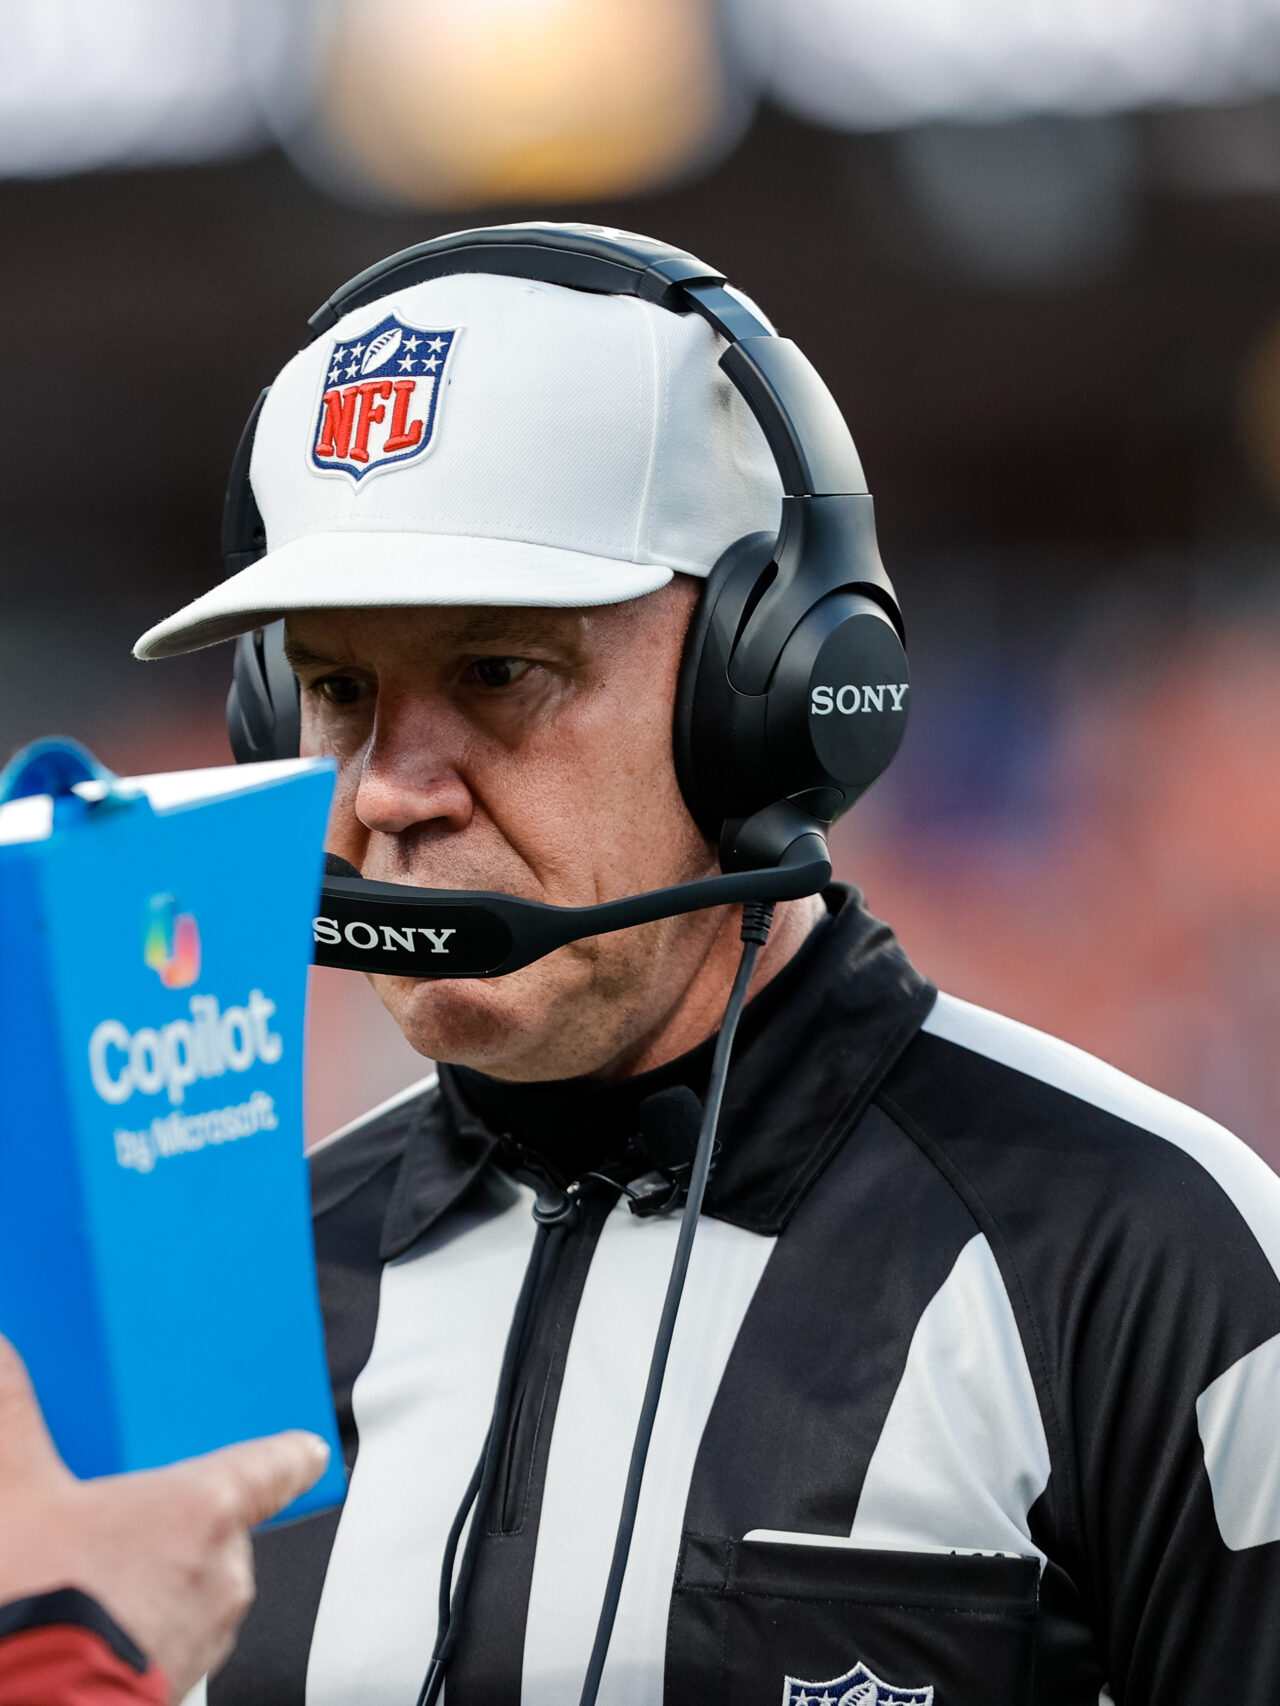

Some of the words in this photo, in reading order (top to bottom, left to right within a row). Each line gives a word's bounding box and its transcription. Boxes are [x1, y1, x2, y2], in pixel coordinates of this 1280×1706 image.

[315, 380, 423, 463] NFL
[811, 684, 909, 715] SONY
[311, 916, 456, 953] SONY
[89, 989, 283, 1106] Copilot
[114, 1129, 157, 1174] by
[152, 1091, 279, 1158] Microsoft
